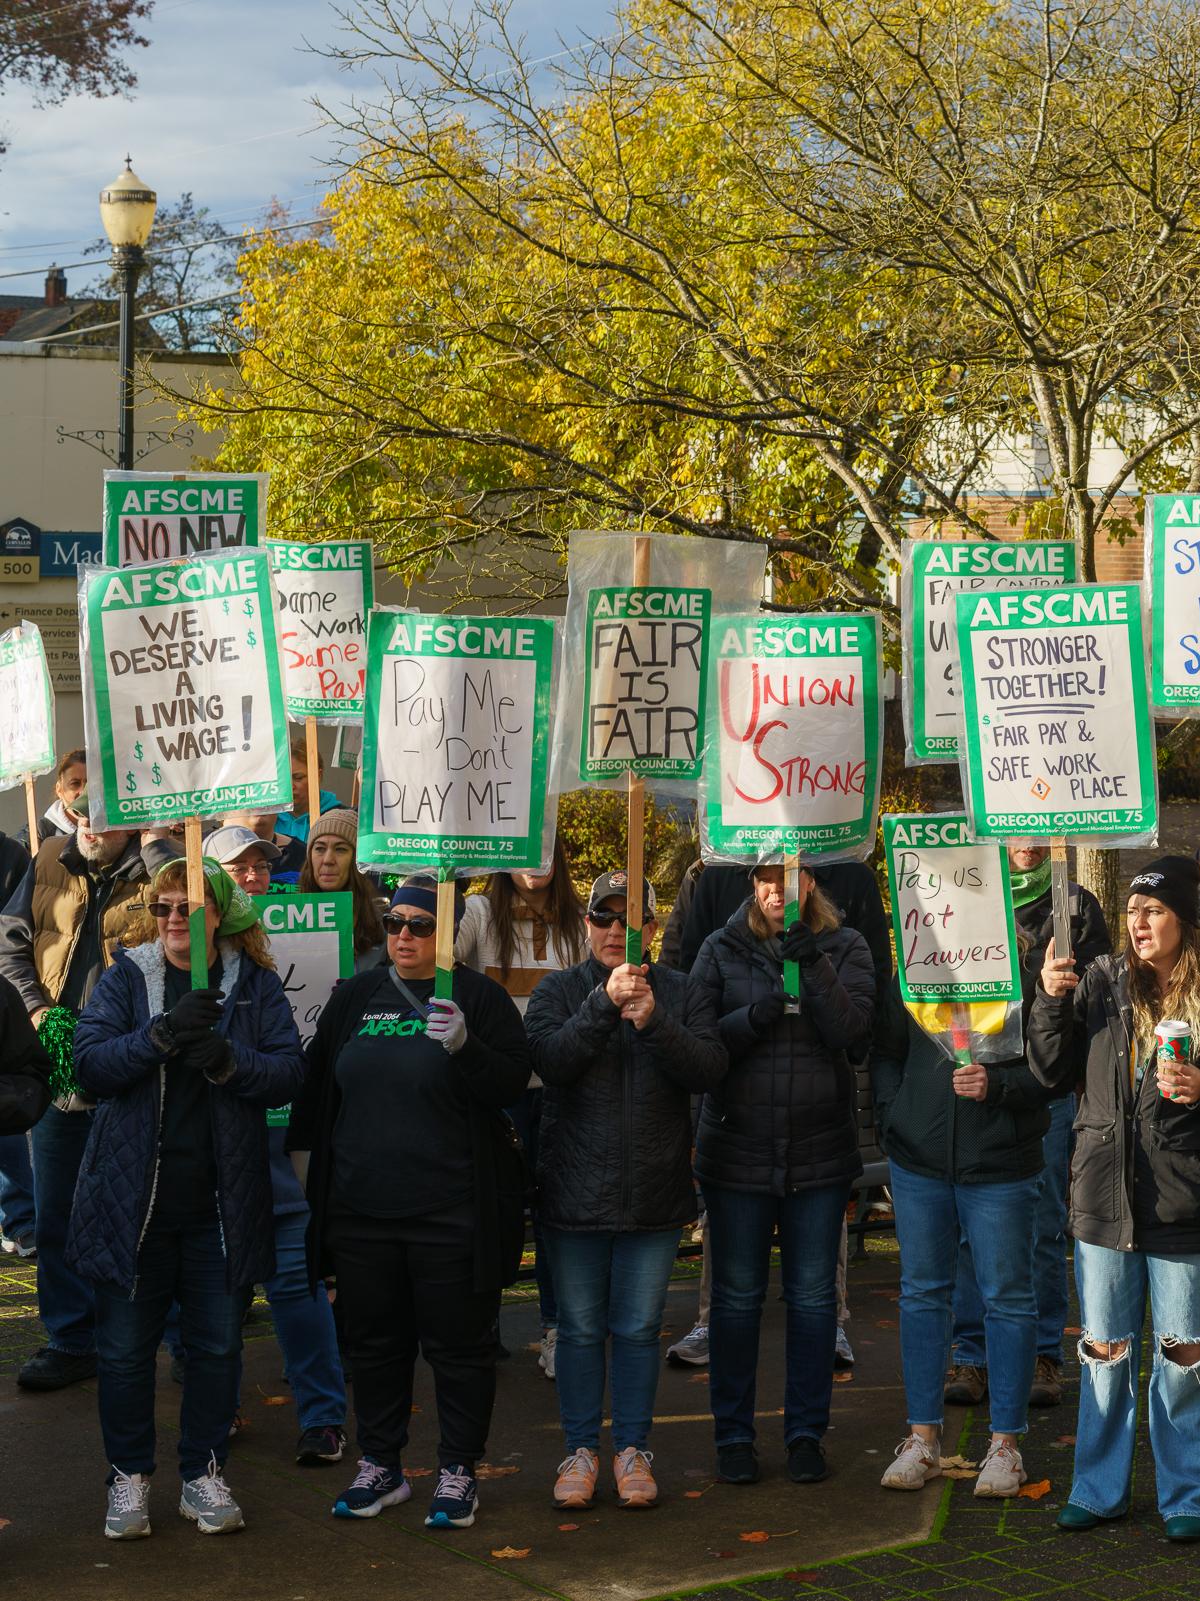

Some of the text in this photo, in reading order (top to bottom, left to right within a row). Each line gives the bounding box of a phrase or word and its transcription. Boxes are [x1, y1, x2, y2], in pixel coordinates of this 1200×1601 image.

[122, 489, 243, 512] AFSCME
[124, 513, 246, 561] NO NEW
[3, 563, 32, 575] 500
[924, 546, 1065, 573] AFSCME
[101, 560, 257, 608] AFSCME
[15, 608, 53, 616] Finance
[594, 592, 703, 617] AFSCME
[970, 591, 1128, 627] AFSCME
[139, 610, 203, 642] WE
[300, 613, 365, 638] Work
[387, 624, 535, 656] AFSCME
[720, 626, 859, 654] AFSCME
[110, 636, 240, 677] DESERVE
[595, 621, 702, 671] FAIR
[987, 635, 1103, 669] STRONGER
[176, 671, 195, 696] A
[319, 669, 365, 699] Pay!
[618, 671, 669, 705] IS
[981, 665, 1105, 700] TOGETHER!
[135, 695, 224, 731] LIVING
[307, 700, 353, 709] COUNCIL
[394, 659, 522, 749] Pay Me
[721, 660, 855, 742] UNION
[590, 704, 699, 760] FAIR
[993, 720, 1095, 747] FAIR PAY &
[446, 736, 513, 771] Don't
[587, 760, 696, 771] OREGON COUNCIL 75
[728, 720, 868, 805] STRONG
[988, 753, 1101, 782] SAFE WORK
[119, 794, 188, 814] OREGON
[191, 785, 258, 804] COUNCIL
[262, 782, 279, 795] 75
[379, 780, 517, 826] PLAY ME
[1070, 776, 1127, 800] PLACE
[736, 826, 851, 840] OREGON COUNCIL 75
[986, 810, 1143, 827] OREGON COUNCIL 75
[387, 838, 513, 851] OREGON COUNCIL 75
[897, 852, 942, 899] Pay
[905, 904, 954, 931] not
[906, 935, 1007, 971] Lawyers
[908, 982, 1013, 993] OREGON COUNCIL 75
